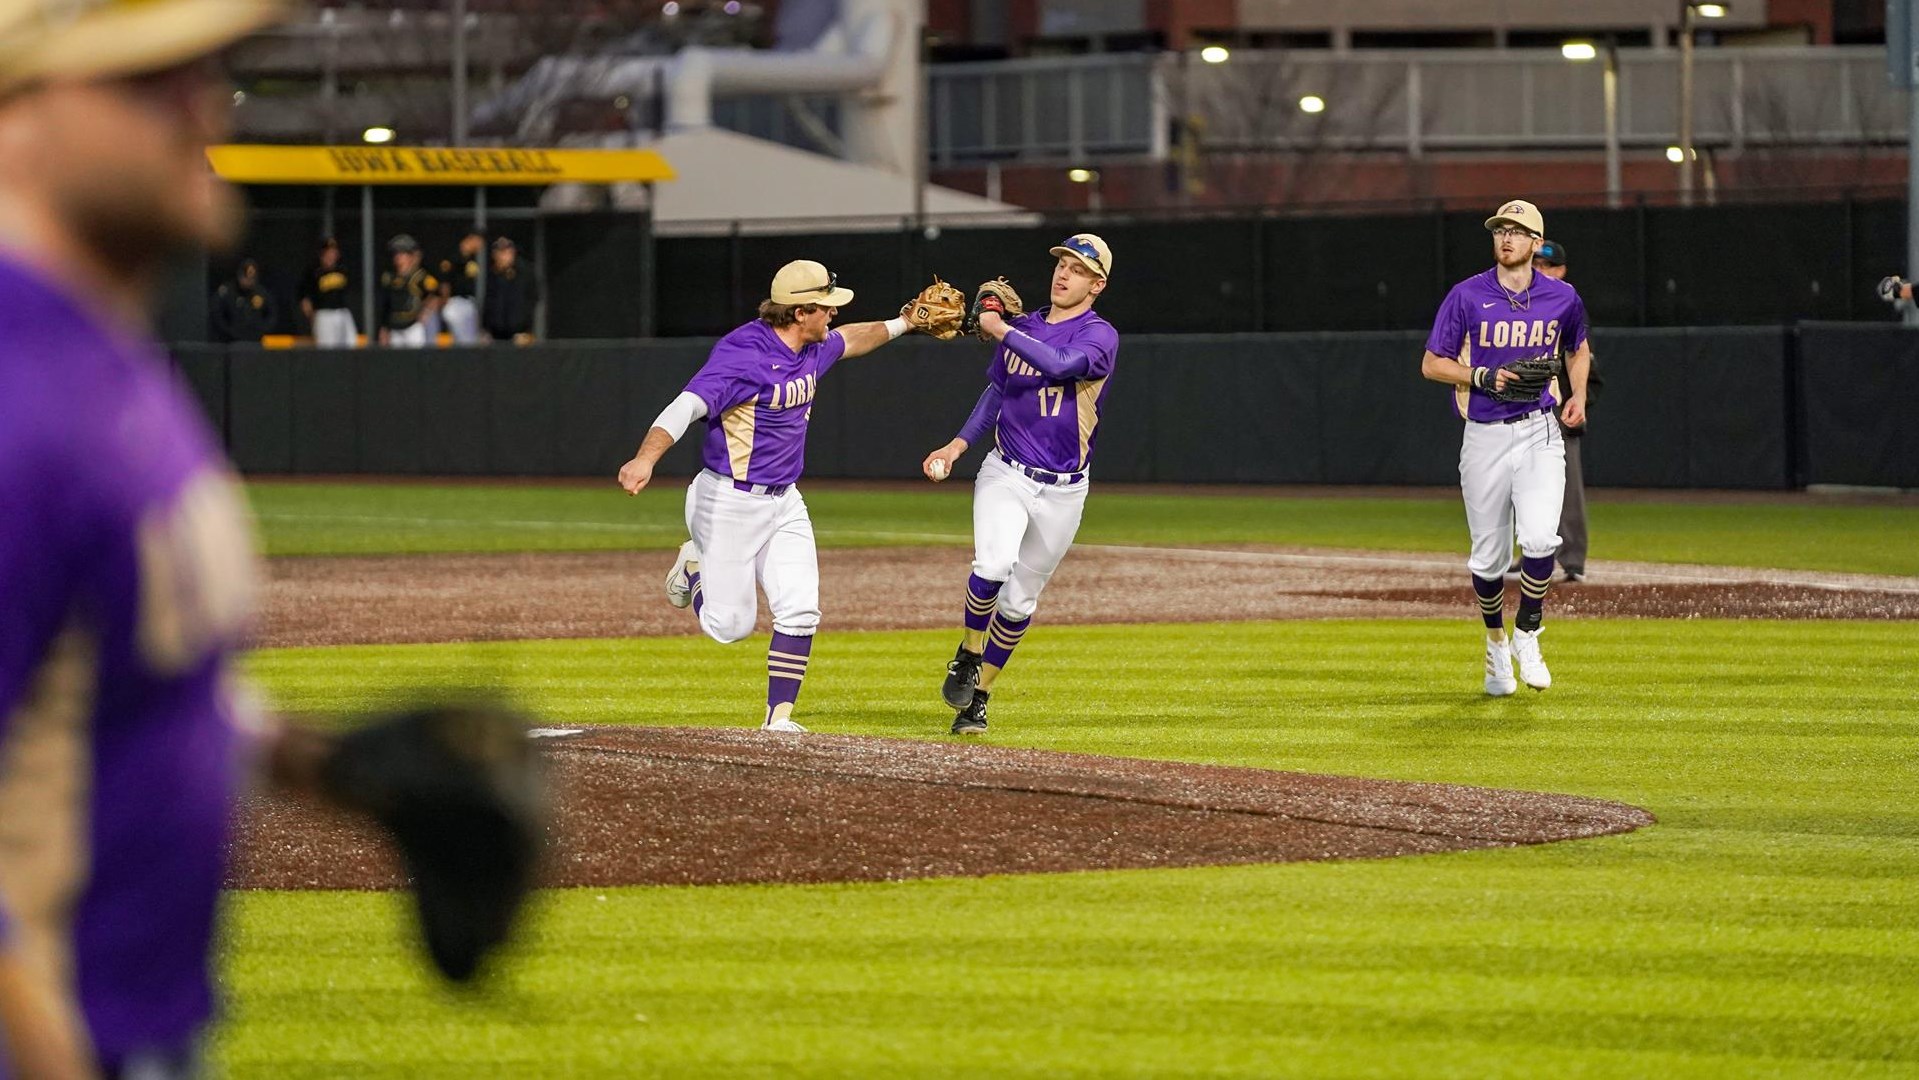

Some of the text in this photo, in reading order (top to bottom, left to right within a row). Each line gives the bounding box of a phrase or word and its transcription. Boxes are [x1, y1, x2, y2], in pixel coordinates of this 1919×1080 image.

[327, 148, 563, 174] IOWA BASEBALL
[1479, 319, 1559, 348] LORAS
[768, 370, 816, 410] LORA
[1038, 386, 1064, 417] 17
